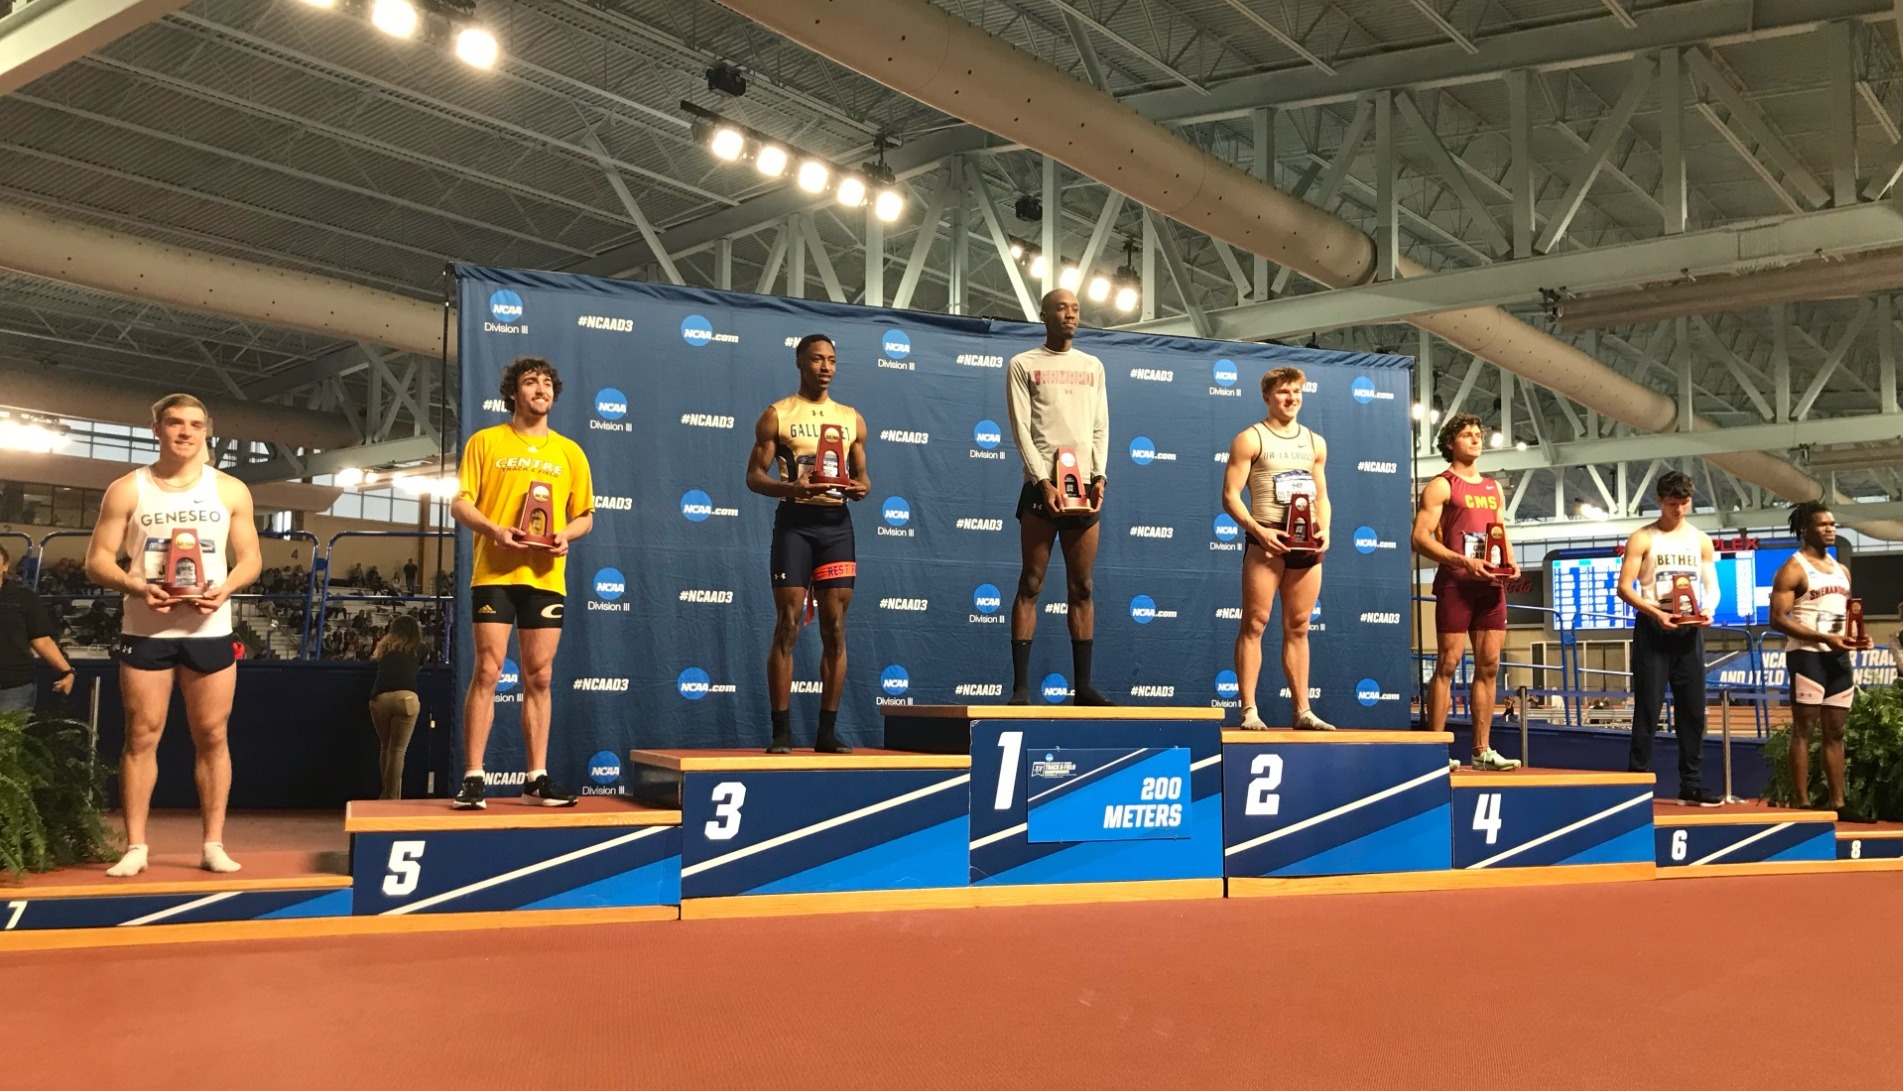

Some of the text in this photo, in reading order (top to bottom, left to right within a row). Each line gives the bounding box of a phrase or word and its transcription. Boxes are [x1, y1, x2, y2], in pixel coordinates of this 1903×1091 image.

[493, 303, 523, 316] NCAA
[484, 322, 518, 334] Division
[578, 315, 633, 332] #NCAAD3
[684, 329, 739, 343] NCAA.com
[885, 342, 910, 353] NCAA
[878, 358, 906, 370] Division
[956, 354, 1003, 368] #NCAAD3
[1130, 368, 1174, 382] #NCAAD3
[1215, 371, 1237, 381] NCAA
[1209, 387, 1234, 396] Division
[599, 402, 627, 413] NCAA
[590, 420, 623, 432] Division
[681, 413, 735, 428] #NCAAD3
[880, 430, 928, 444] #NCAAD3
[976, 432, 1000, 443] NCAA
[970, 450, 998, 459] Division
[1132, 449, 1176, 461] NCAA.com
[495, 457, 563, 475] CENTRE
[1357, 461, 1397, 473] #NCAAD3
[593, 495, 632, 510] CAAD3
[1465, 494, 1497, 510] CMS
[683, 504, 738, 517] NCAA.com
[884, 509, 909, 520] NCAA
[141, 510, 221, 527] GENESEO
[956, 518, 1003, 532] #NCAAD3
[878, 526, 906, 537] Division
[1130, 526, 1173, 539] #NCAAD3
[1216, 525, 1238, 535] NCAA
[1209, 542, 1235, 551] Division
[1713, 537, 1759, 551] PLEX
[1657, 554, 1698, 566] BETHEL
[828, 564, 849, 577] REST
[596, 582, 624, 593] NCAA
[679, 590, 733, 604] #NCAAD3
[976, 597, 1000, 606] NCAA
[540, 603, 564, 618] C
[587, 601, 621, 611] Division
[880, 598, 928, 611] #NCAAD3
[969, 615, 997, 624] Division
[1132, 608, 1177, 618] NCAA.com
[1360, 612, 1400, 624] #NCAAD3
[1762, 652, 1787, 668] NCA
[573, 678, 629, 691] #NCAAD3
[883, 678, 908, 688] NCAA
[1720, 671, 1746, 685] AND
[681, 682, 736, 693] NCAA.com
[955, 684, 1002, 696] #NCAAD3
[1131, 685, 1174, 697] #NCAAD3
[1217, 683, 1239, 691] NCAA
[876, 697, 904, 705] Division
[591, 766, 620, 776] NCAA
[994, 731, 1023, 810] 1
[484, 772, 528, 785] NCAAD
[1244, 753, 1284, 815] 2
[582, 785, 617, 796] Division
[1140, 776, 1182, 800] 200
[704, 781, 747, 840] 3
[1103, 804, 1182, 828] METERS
[1472, 793, 1502, 844] 4
[1671, 829, 1688, 861] 6
[1851, 840, 1861, 859] 8
[382, 841, 426, 896] 5
[5, 901, 28, 930] 7
